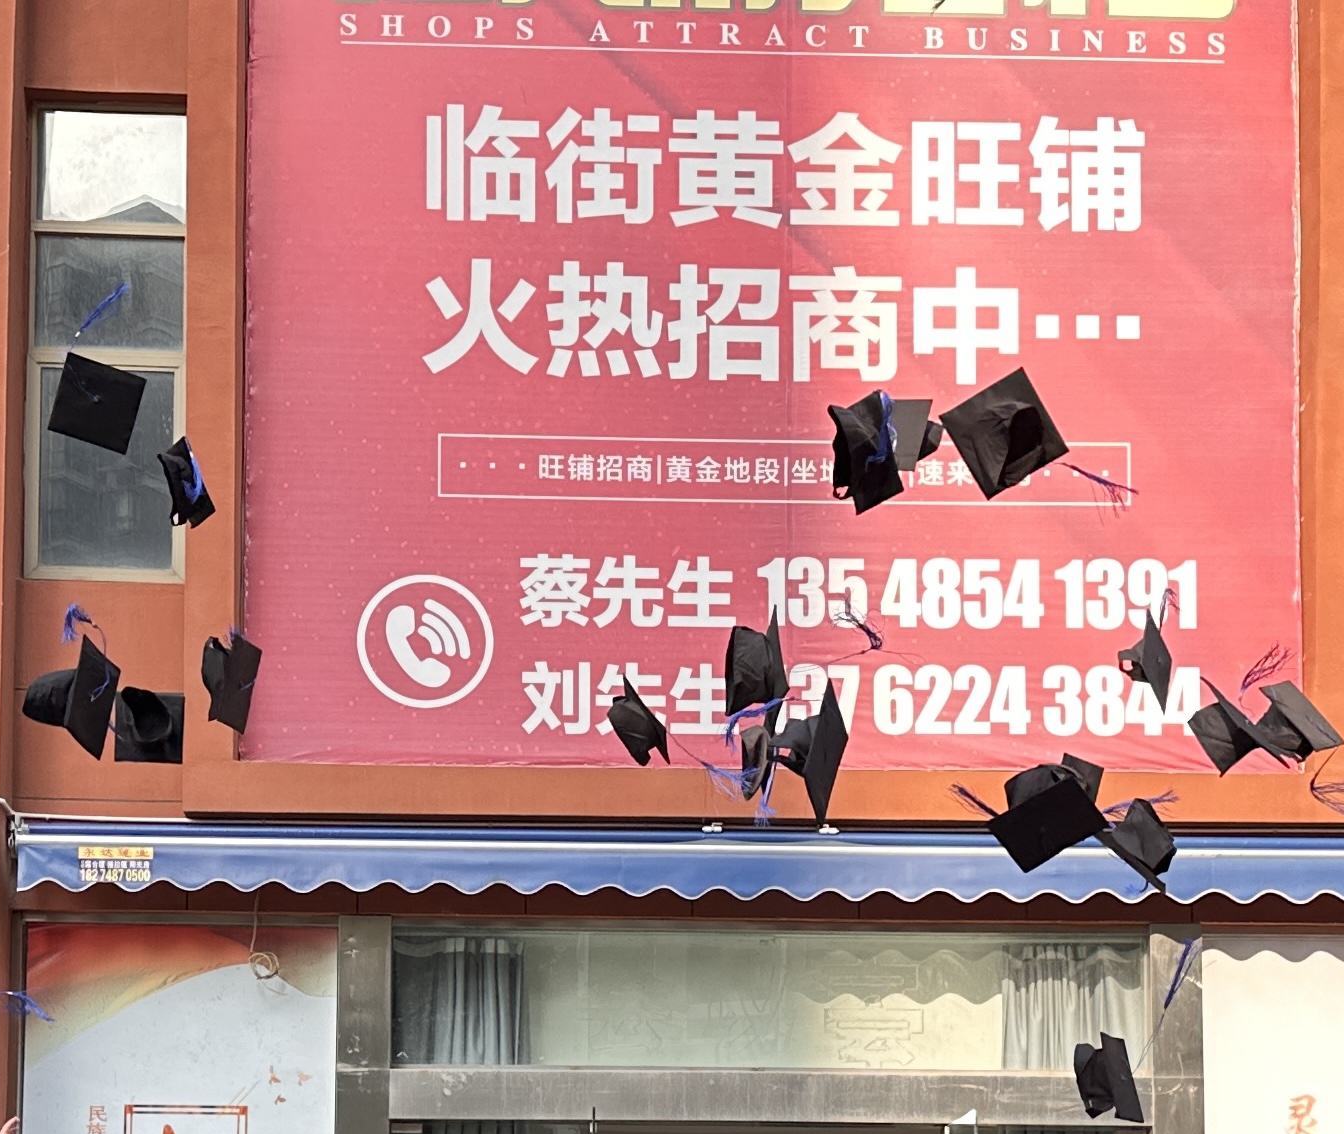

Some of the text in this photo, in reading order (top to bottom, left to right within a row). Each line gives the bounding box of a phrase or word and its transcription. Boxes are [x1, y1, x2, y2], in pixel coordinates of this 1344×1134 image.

[339, 13, 1226, 55] SHOPS ATTRACT BUSINESS
[423, 104, 1146, 233] 临街黄金旺铺
[519, 553, 1198, 631] 蔡先生 135 4854 1391
[773, 663, 860, 736] 37
[873, 664, 1032, 736] 6224
